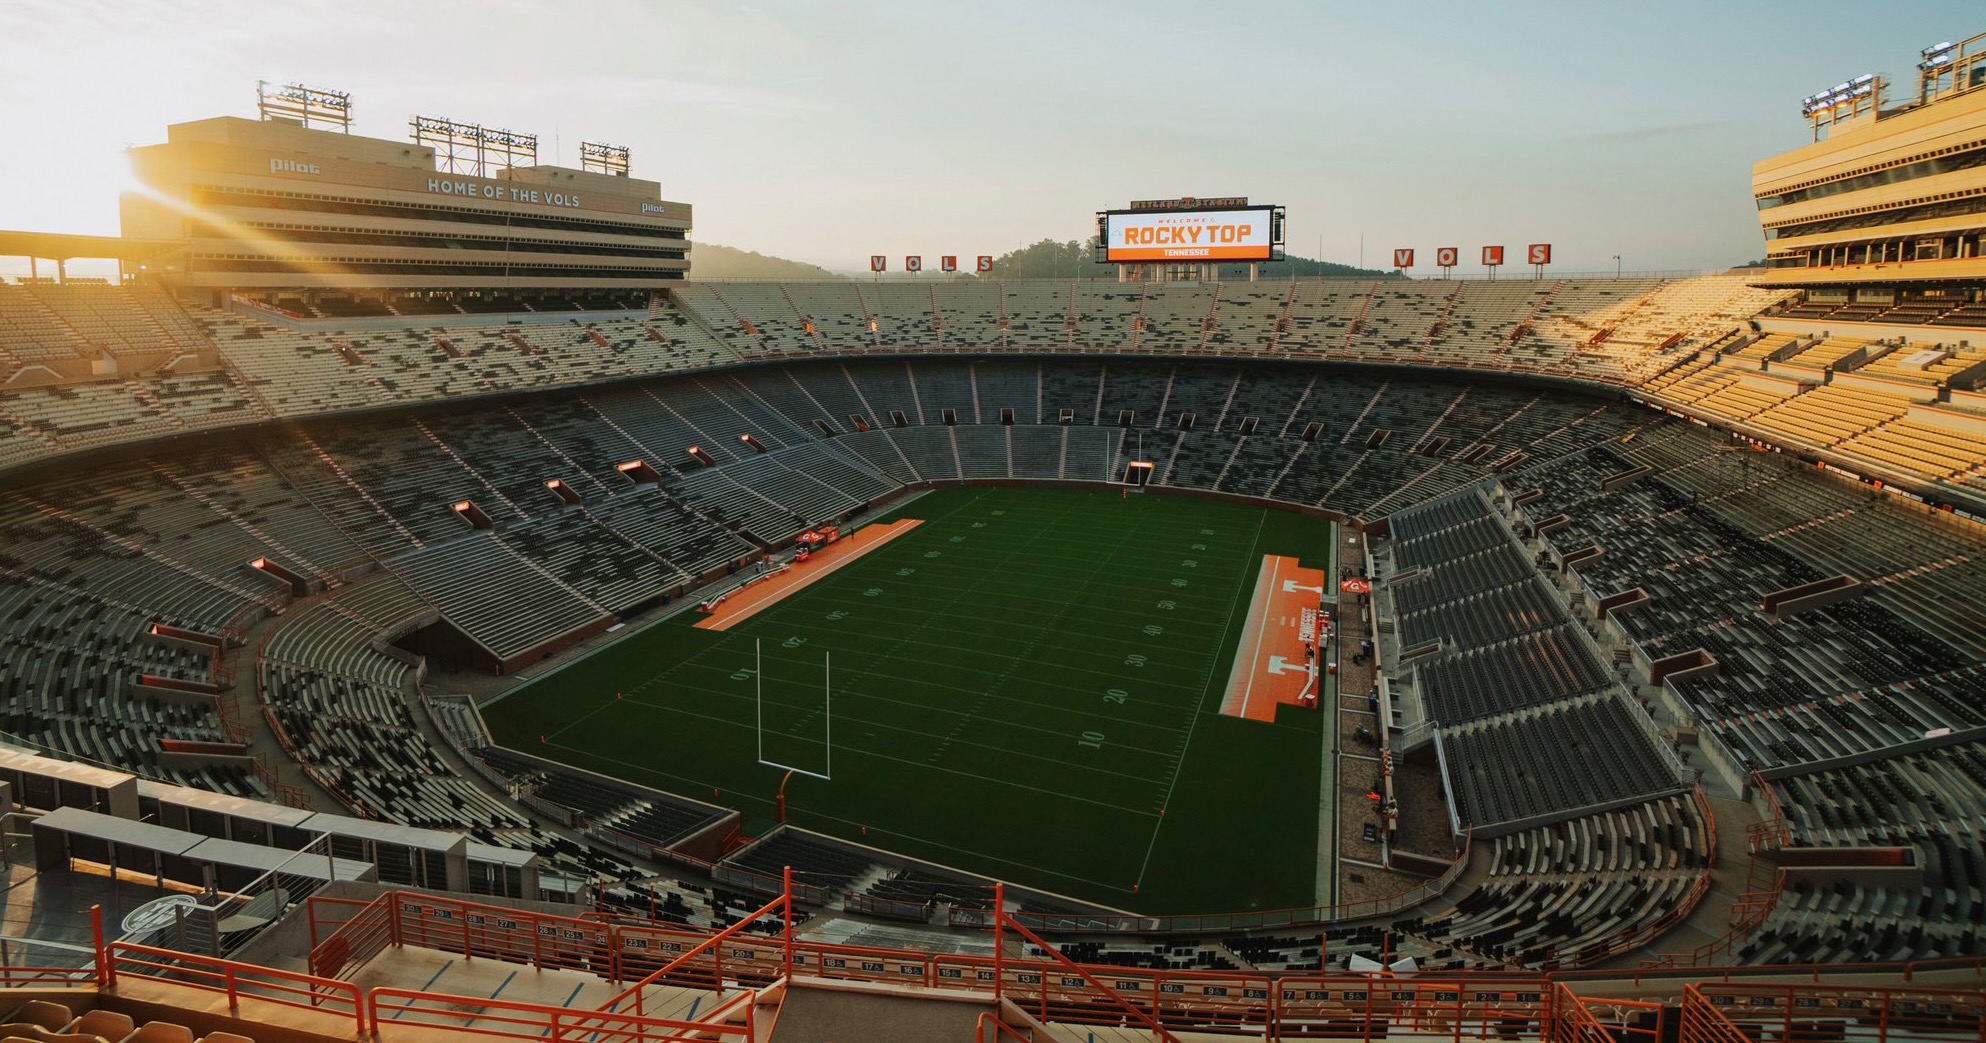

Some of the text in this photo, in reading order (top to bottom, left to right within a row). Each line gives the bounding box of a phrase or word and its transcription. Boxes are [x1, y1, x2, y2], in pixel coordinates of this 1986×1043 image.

[428, 179, 580, 207] HOME OF THE VOLS
[1124, 225, 1252, 245] ROCKY TOP
[1143, 624, 1162, 636] 40
[782, 636, 808, 648] 20
[1124, 654, 1147, 667] 30
[730, 668, 757, 680] 10
[1103, 689, 1128, 704] 20
[1078, 731, 1105, 749] 10
[468, 914, 477, 922] 28
[628, 939, 638, 947] 23
[662, 942, 671, 950] 22
[865, 963, 874, 971] 17
[904, 966, 912, 974] 16
[942, 969, 951, 977] 15
[981, 972, 990, 980] 14
[1065, 978, 1074, 986] 12
[1119, 982, 1127, 990] 11
[1208, 987, 1214, 995] 9
[1248, 990, 1254, 998] 8
[1287, 991, 1293, 999] 7
[1310, 991, 1316, 999] 6
[1348, 992, 1354, 1000] 5
[1481, 993, 1487, 1001] 2
